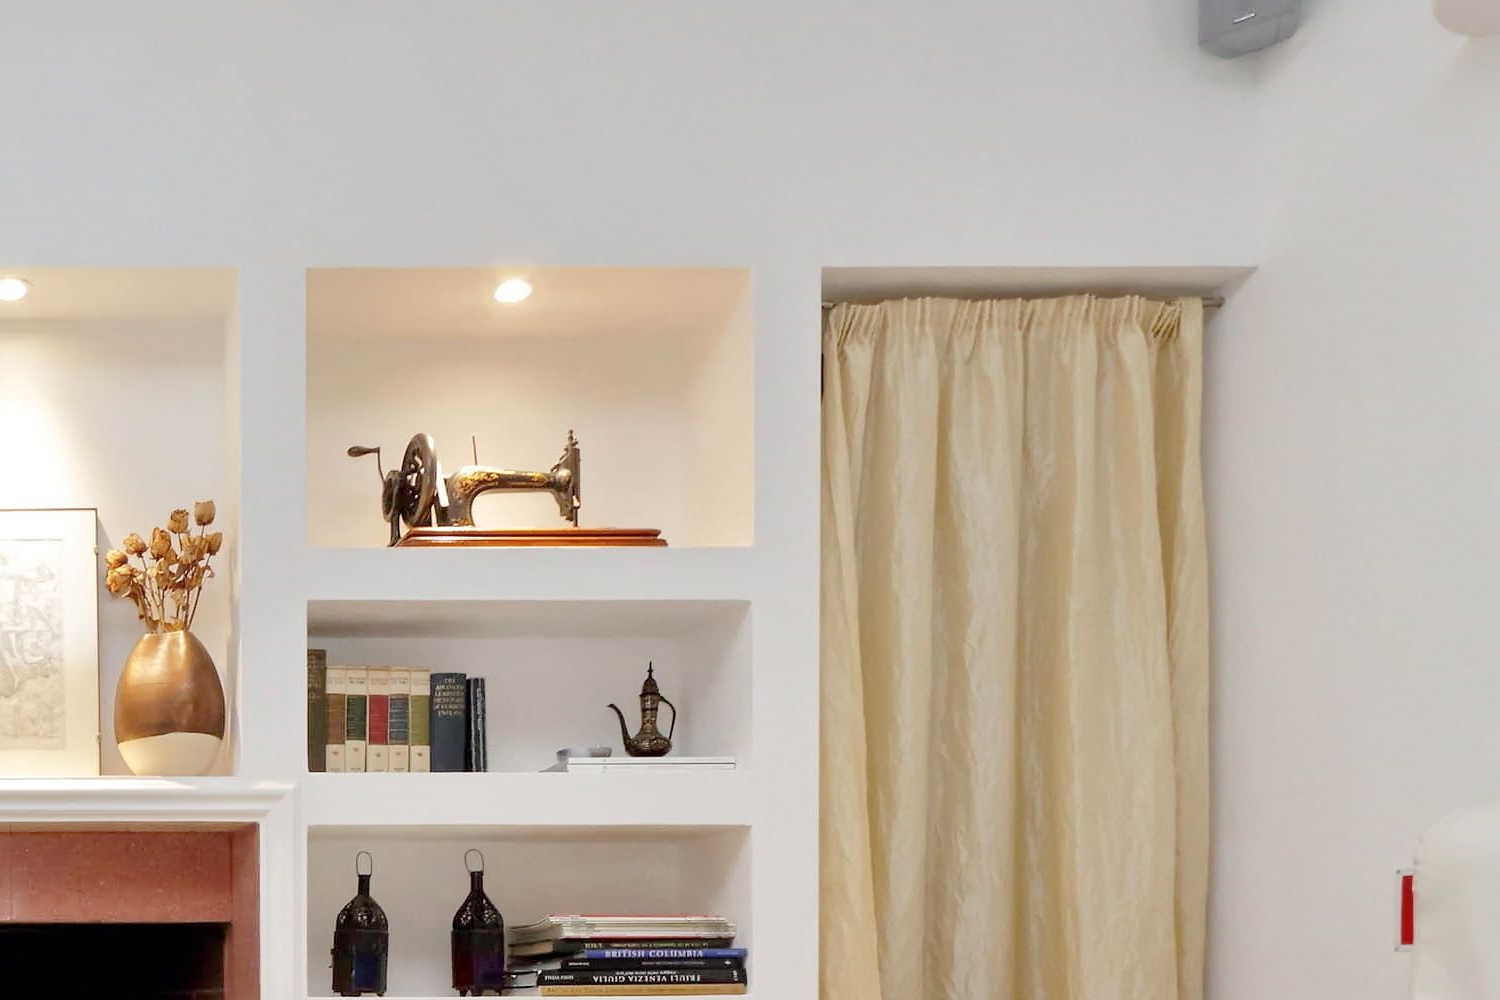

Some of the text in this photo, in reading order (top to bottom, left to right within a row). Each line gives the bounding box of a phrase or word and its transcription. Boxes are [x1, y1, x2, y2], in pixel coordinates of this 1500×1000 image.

[605, 949, 704, 958] BRITISH COLUMBIA
[593, 975, 626, 983] GIULIA
[629, 975, 667, 983] VENEZIA
